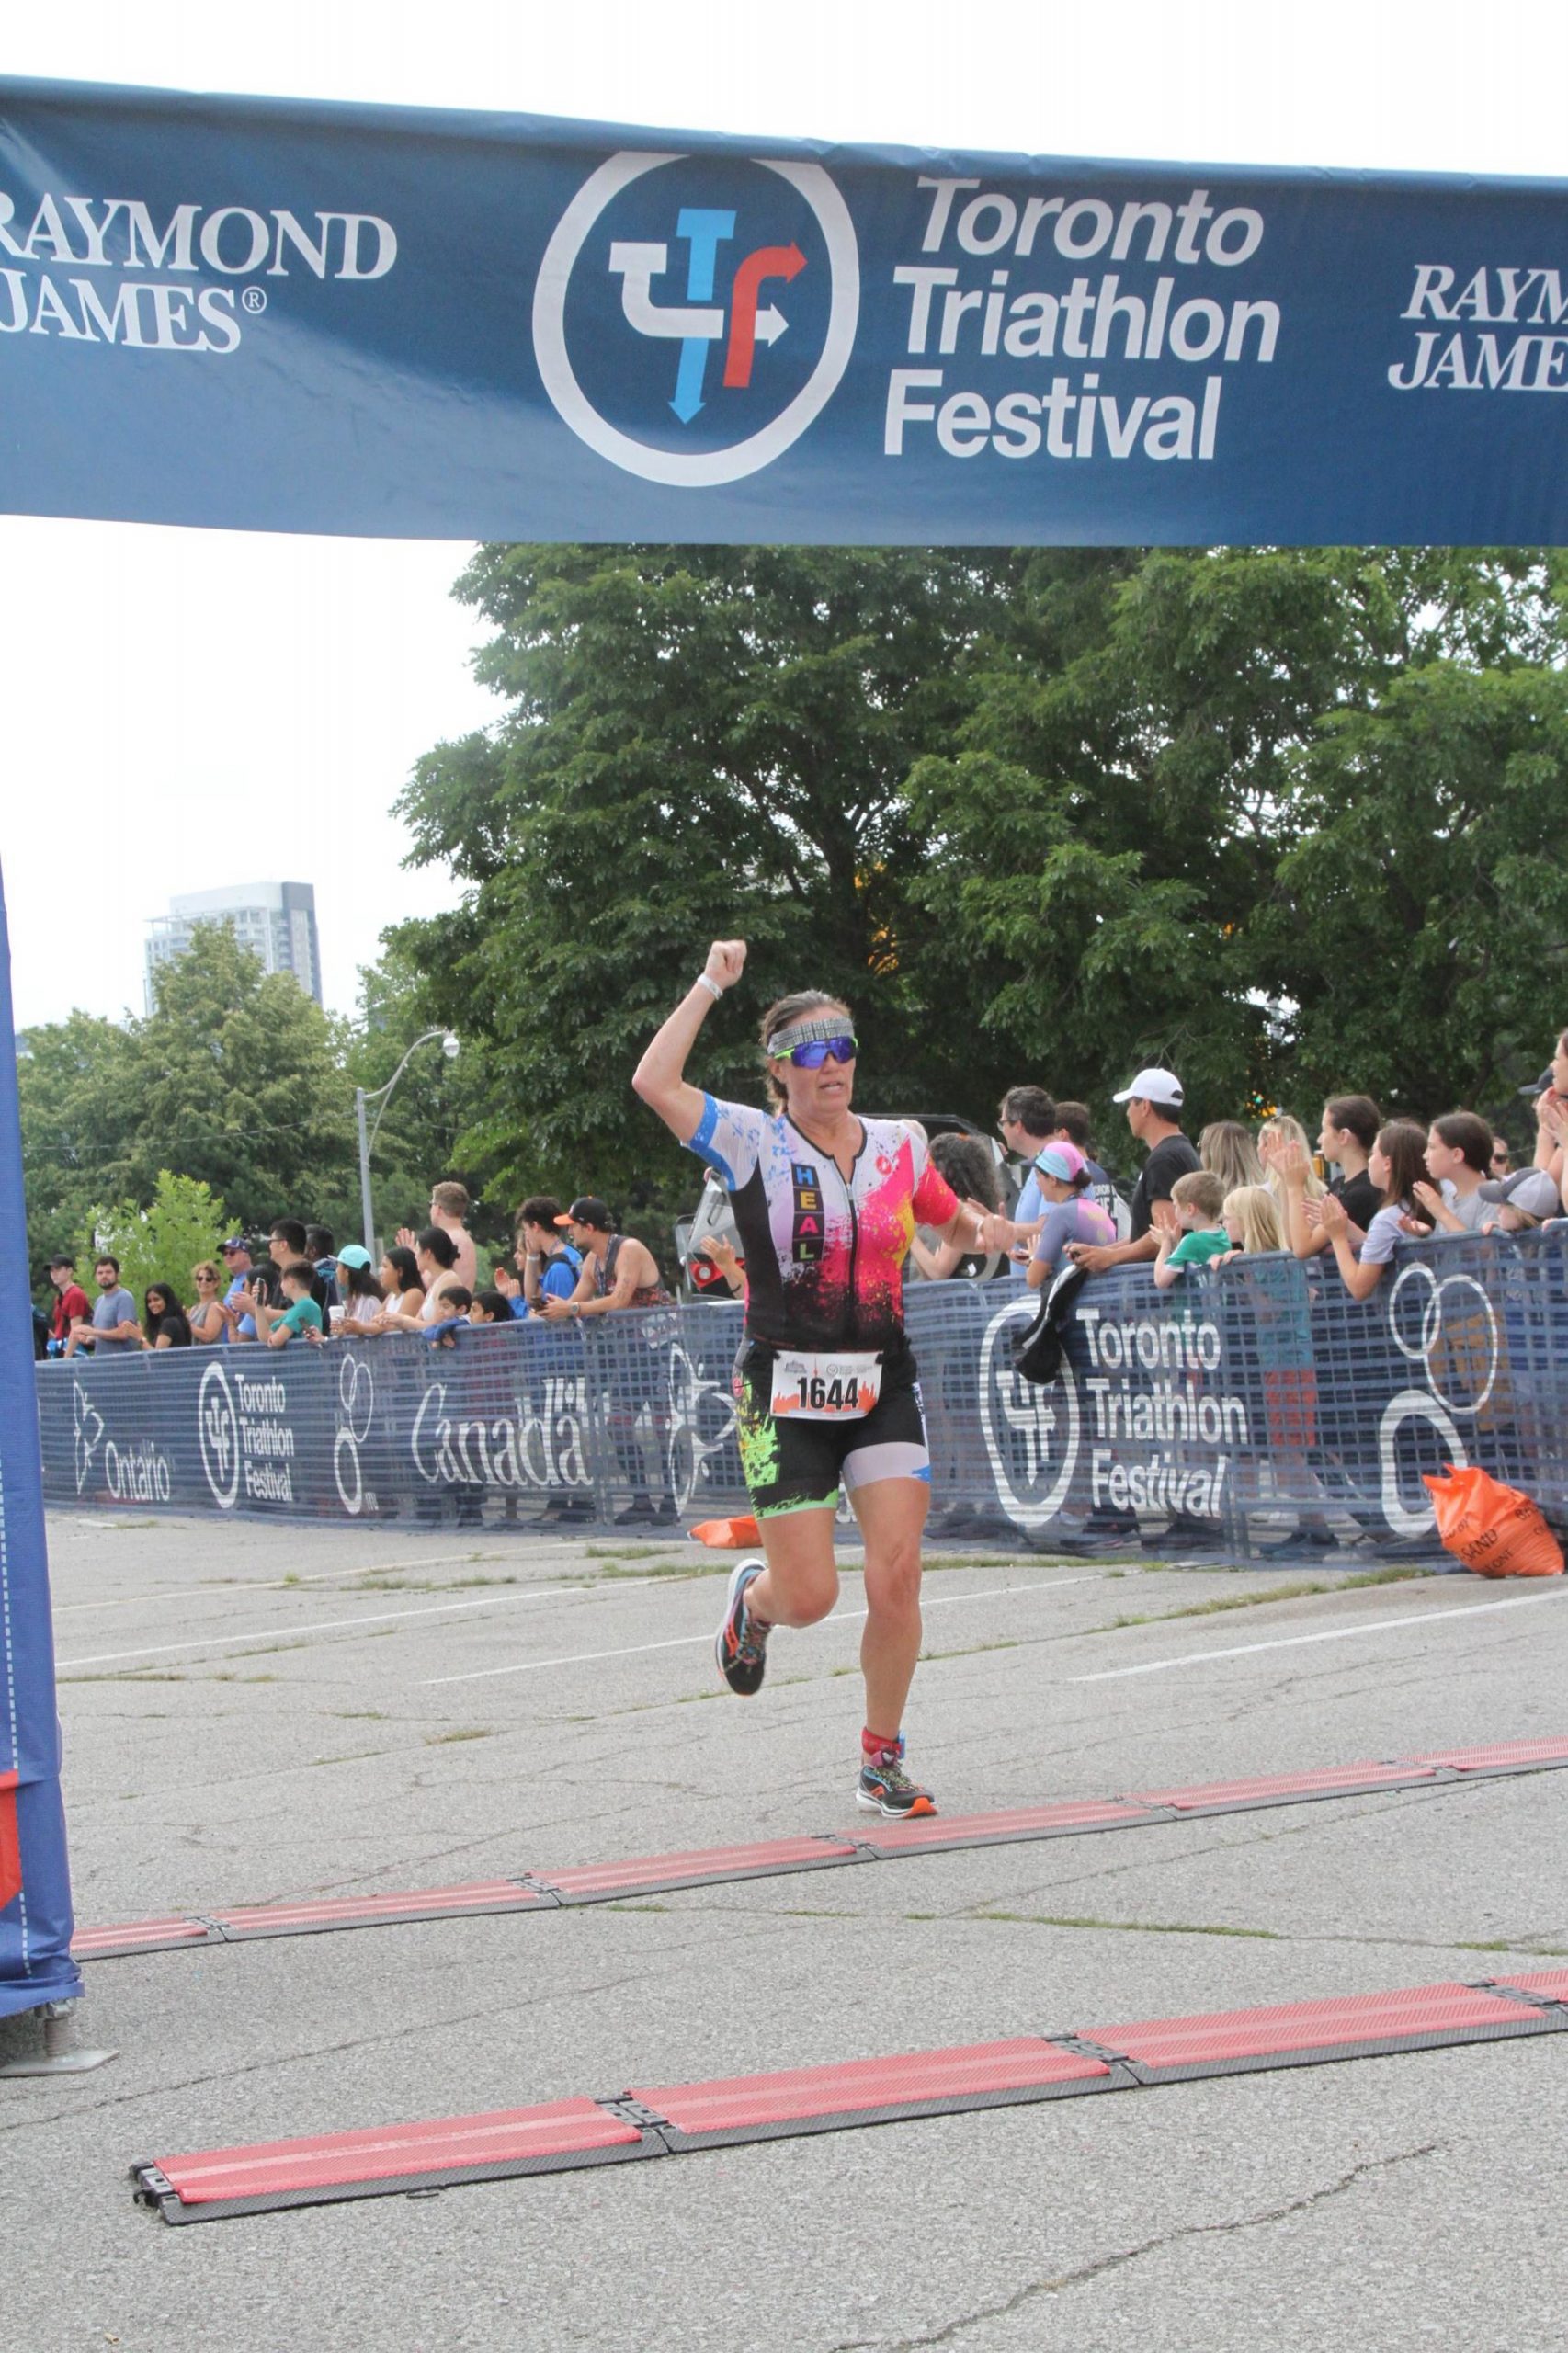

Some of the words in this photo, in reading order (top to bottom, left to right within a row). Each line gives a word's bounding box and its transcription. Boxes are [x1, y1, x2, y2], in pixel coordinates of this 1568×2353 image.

[916, 176, 1265, 267] Toronto
[893, 266, 1280, 362] Triathlon
[884, 369, 1222, 460] Festival
[796, 1166, 819, 1260] HEAL
[1076, 1307, 1221, 1370] Toronto
[234, 1373, 286, 1413] Toronto
[797, 1376, 858, 1410] 1644
[1086, 1378, 1248, 1444] Triathlon
[239, 1415, 294, 1457] Triathlon
[411, 1378, 594, 1487] Canada
[105, 1440, 170, 1501] Ontario
[244, 1460, 293, 1502] Festival
[1092, 1449, 1230, 1517] Festival
